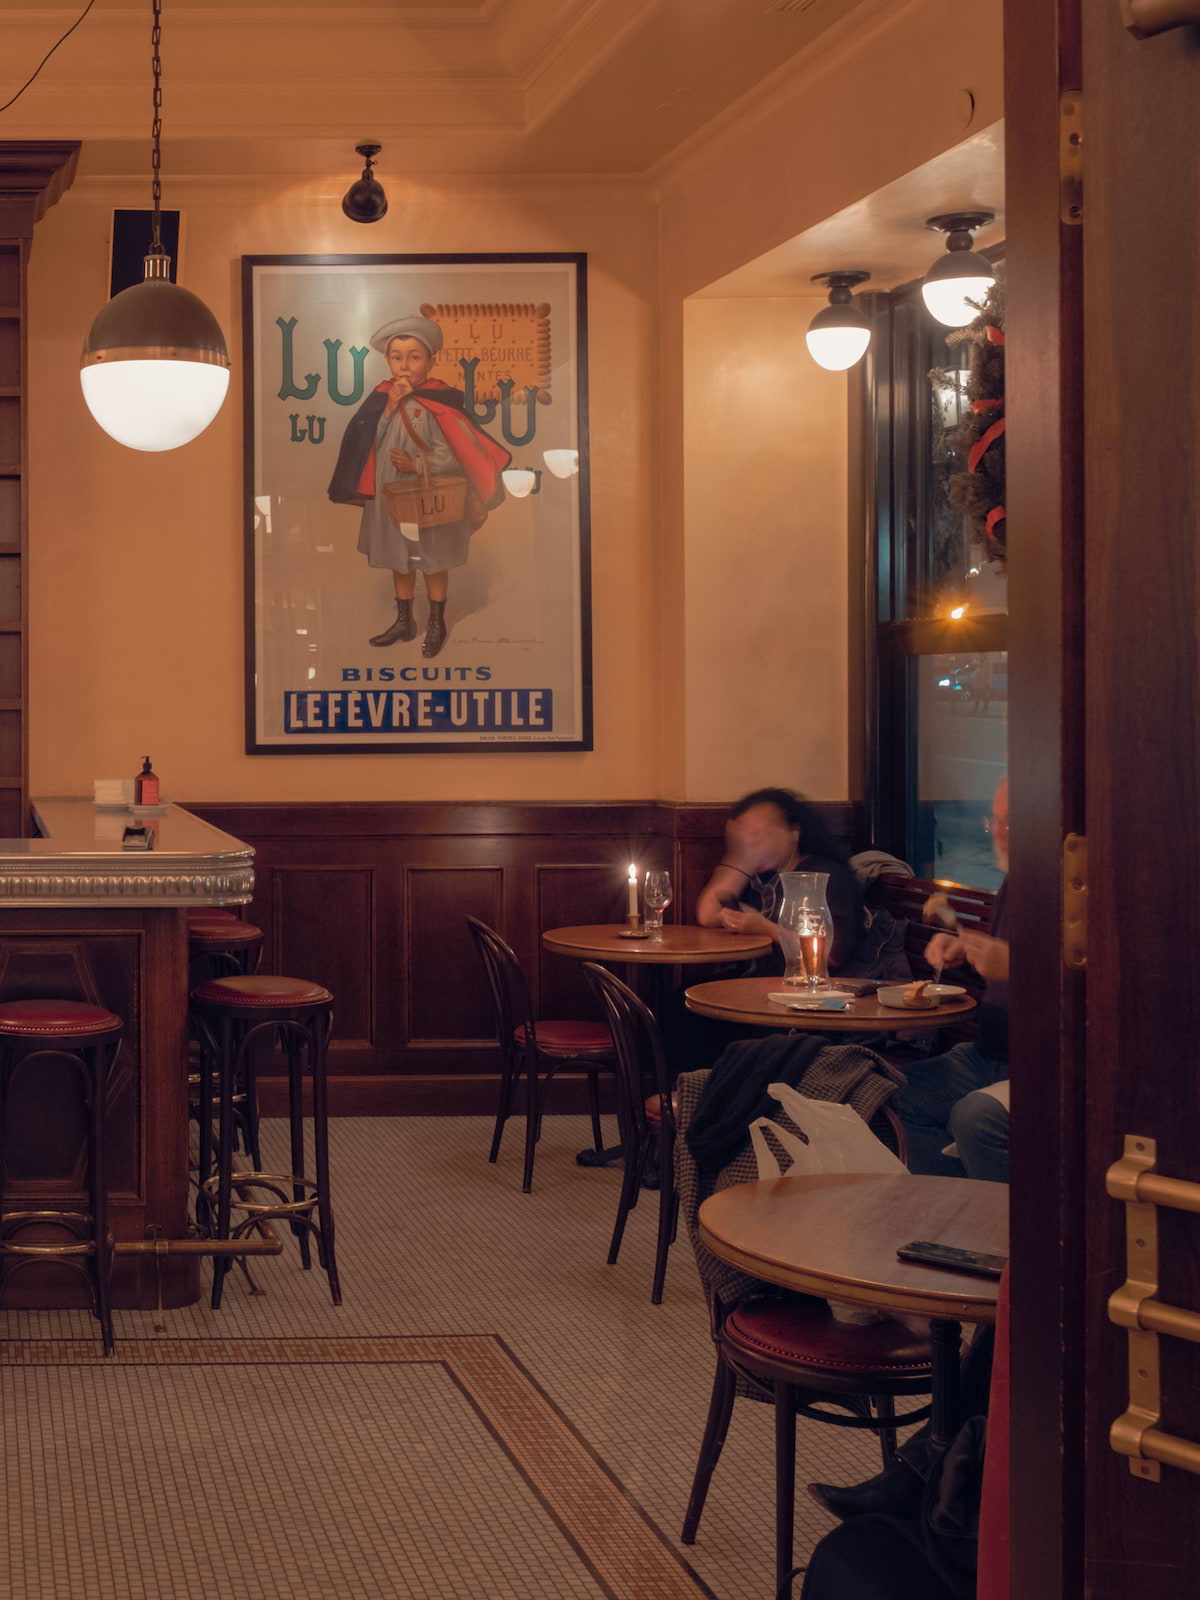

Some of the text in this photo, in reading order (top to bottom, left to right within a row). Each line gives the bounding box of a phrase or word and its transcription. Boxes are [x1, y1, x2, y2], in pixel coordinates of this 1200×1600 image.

[275, 316, 370, 406] LU
[458, 371, 512, 382] NNTES
[459, 356, 539, 447] LU
[289, 413, 327, 445] LU
[341, 666, 492, 683] BISCUITS
